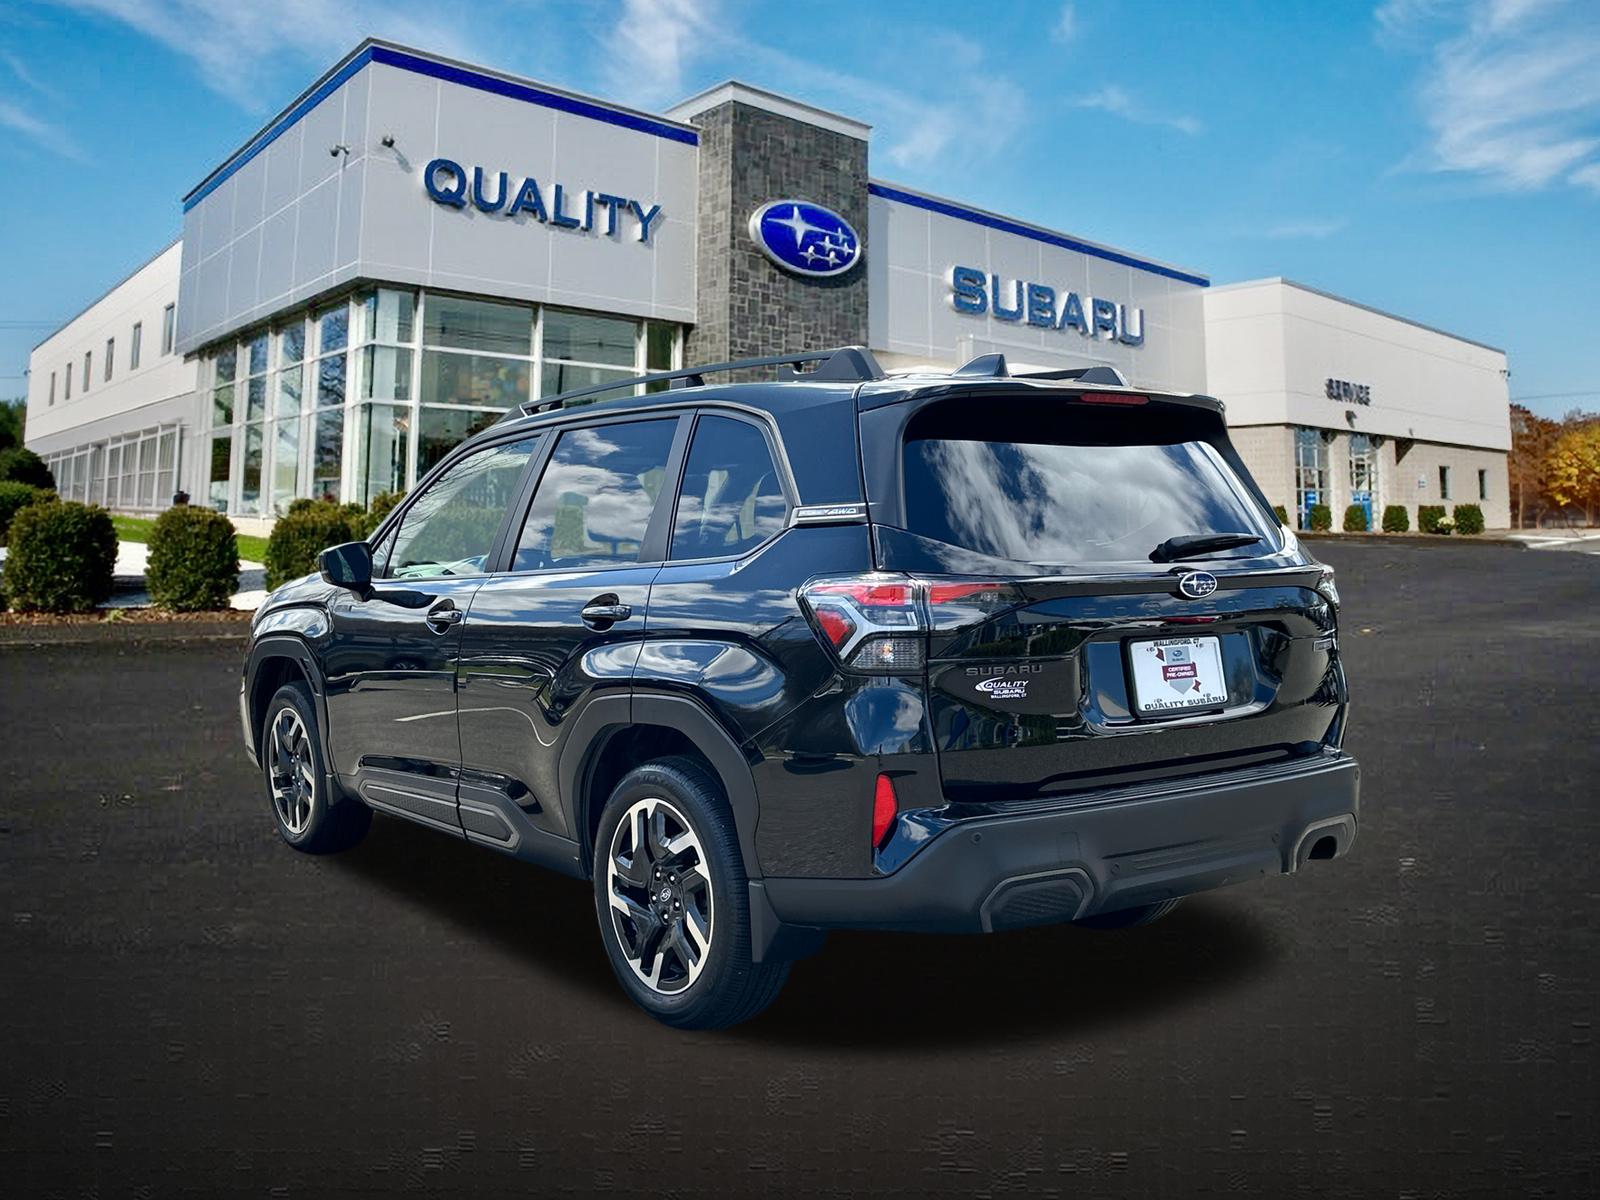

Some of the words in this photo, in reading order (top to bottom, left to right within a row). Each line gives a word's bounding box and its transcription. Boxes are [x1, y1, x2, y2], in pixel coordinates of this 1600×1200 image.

[424, 158, 661, 243] QUALITY
[952, 265, 1145, 347] SUBARU
[966, 665, 1042, 675] SUBARU
[985, 680, 1029, 688] QUALITY
[1144, 700, 1185, 710] QUALITY
[1187, 695, 1226, 705] SUBARU
